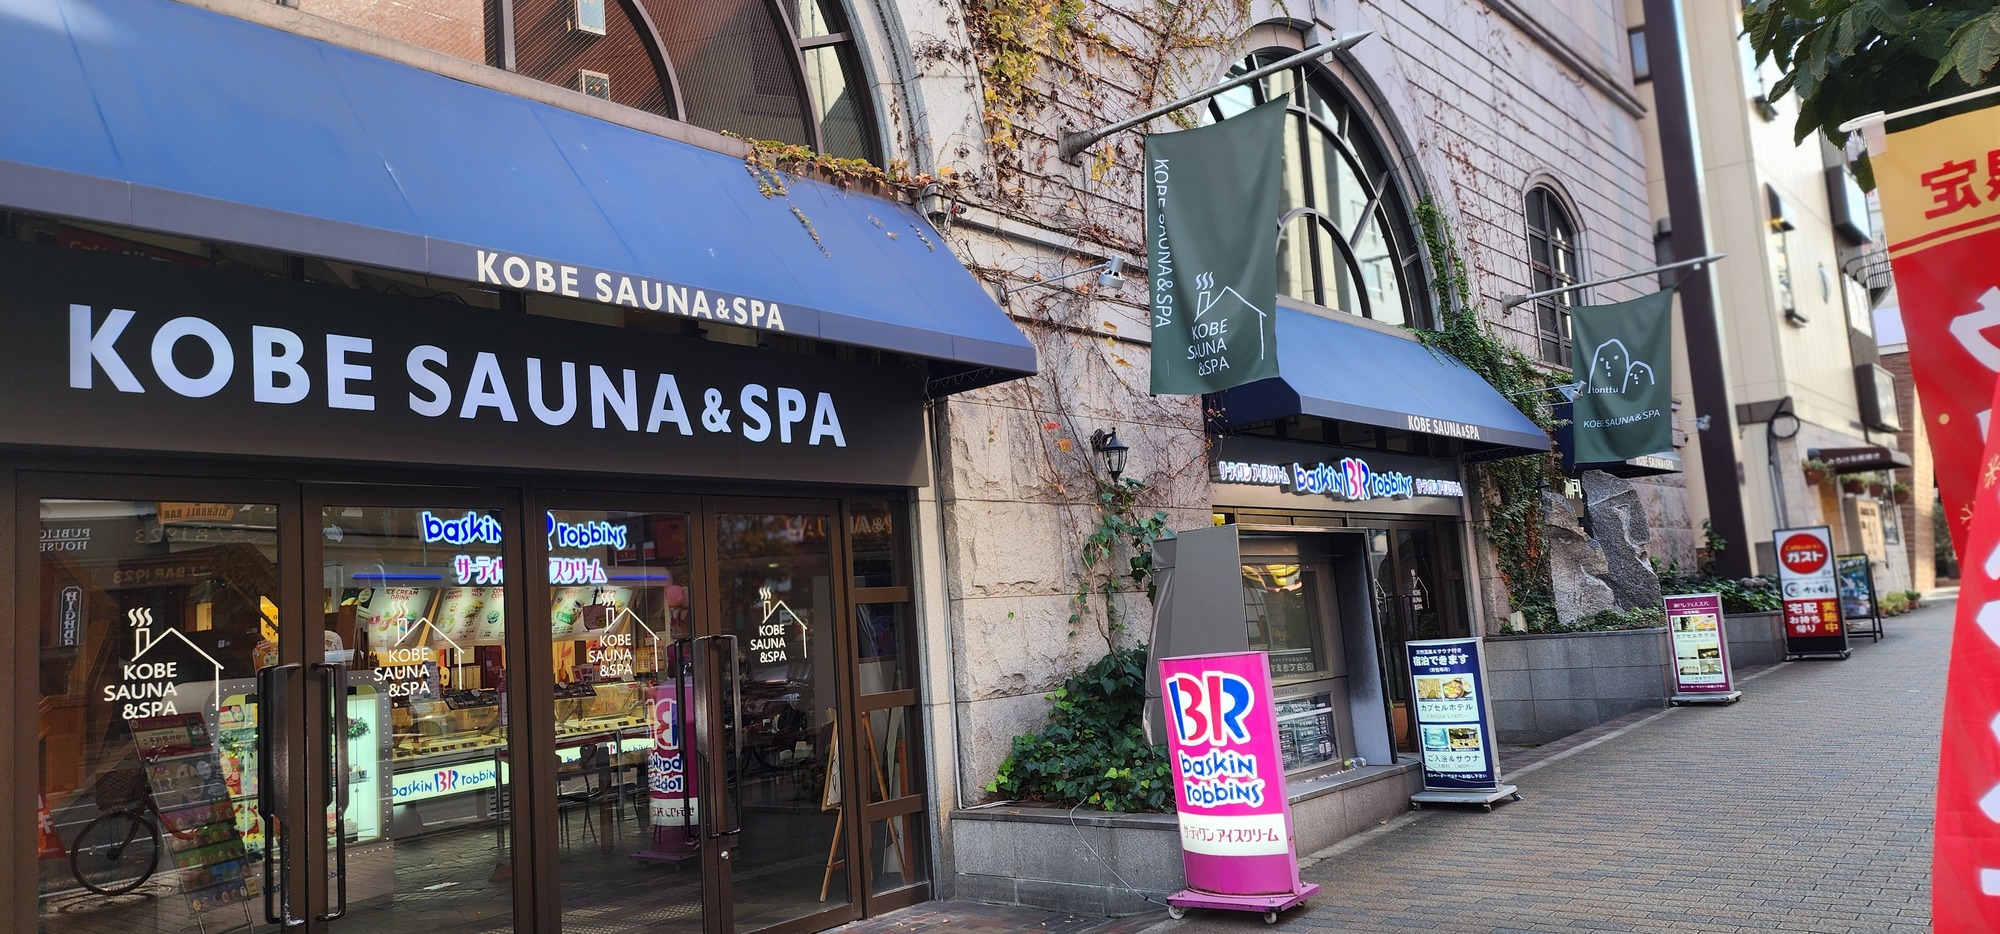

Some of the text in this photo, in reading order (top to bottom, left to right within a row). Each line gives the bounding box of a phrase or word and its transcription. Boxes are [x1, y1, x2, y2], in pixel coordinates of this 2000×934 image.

[1921, 148, 2000, 220] 宝
[477, 250, 785, 331] KOBE SAUNA&SPA
[1192, 318, 1228, 341] KOBE
[1187, 337, 1228, 360] SAUNA
[69, 303, 846, 448] KOBE SAUNA&SPA
[1198, 356, 1230, 377] &SPA
[1407, 415, 1480, 441] KOBE SAUNA&SPA
[1219, 461, 1290, 485] サーティワン アイスクリーム
[1295, 463, 1343, 494] baskin
[1371, 472, 1413, 499] robbins
[559, 521, 626, 548] robbins
[1787, 551, 1823, 563] ガスト
[457, 558, 606, 582] サーティ スクリーム
[1788, 603, 1818, 614] 宅配
[1821, 601, 1838, 633] 実施中
[1789, 615, 1821, 624] お持ち
[1796, 625, 1816, 633] 帰り
[759, 624, 785, 637] KOBE
[600, 633, 632, 648] KOBE
[750, 637, 786, 651] SAUNA
[388, 647, 430, 663] KOBE
[588, 648, 632, 663] SAUNA
[760, 651, 787, 663] &SPA
[1412, 654, 1469, 667] 宿泊できます
[124, 662, 178, 681] KOBE
[373, 664, 430, 682] SAUNA
[600, 663, 633, 677] &SPA
[103, 682, 178, 702] SAUNA
[388, 681, 431, 698] &SPA
[122, 701, 178, 720] &SPA
[1168, 675, 1250, 741] BR
[1421, 703, 1474, 712] カプセルホテル
[1180, 752, 1254, 776] baskin
[1428, 754, 1480, 763] ご入浴&サウナ
[434, 769, 459, 793] BR
[461, 769, 496, 787] robbin
[1186, 781, 1261, 803] robbins
[1183, 824, 1279, 843] サーティワン アイスクリーム
